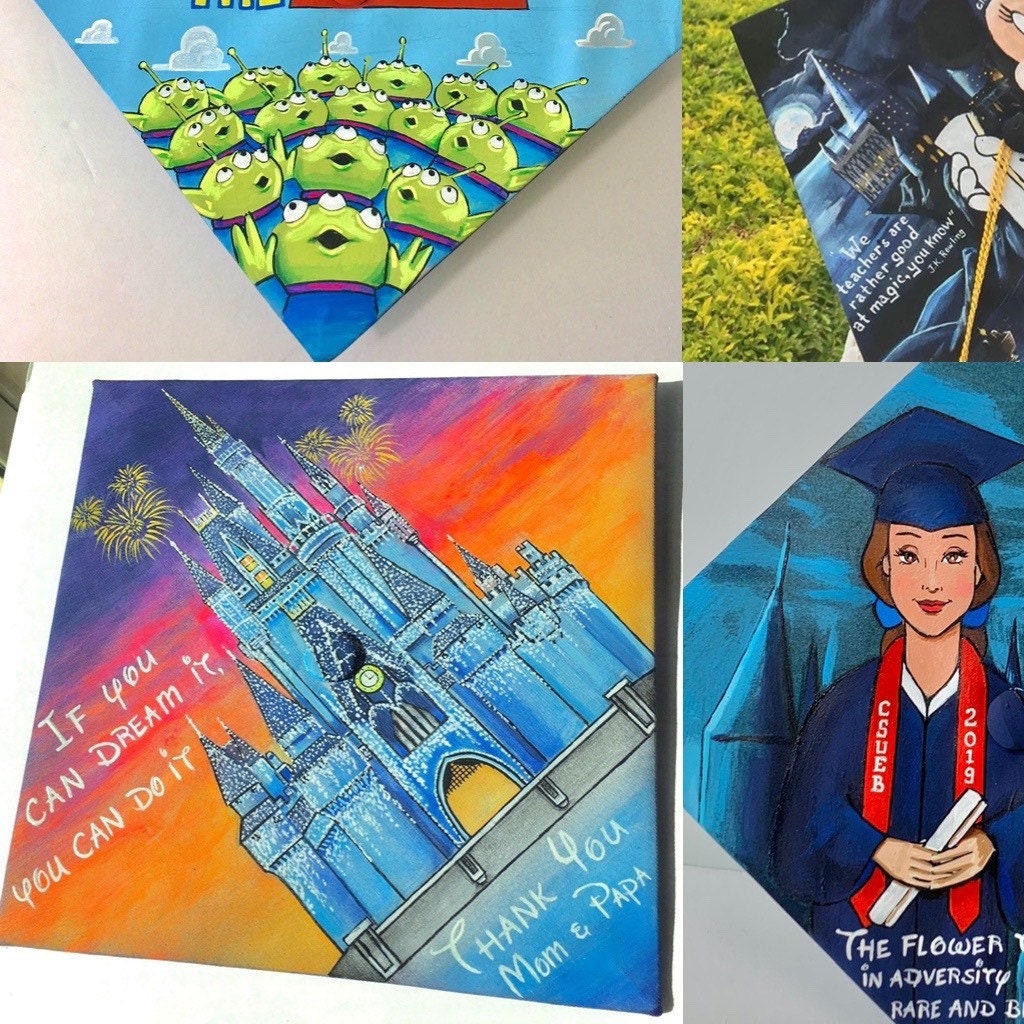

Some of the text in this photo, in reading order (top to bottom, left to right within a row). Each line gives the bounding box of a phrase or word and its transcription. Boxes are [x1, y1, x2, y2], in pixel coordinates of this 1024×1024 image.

[836, 215, 909, 295] teachers are
[849, 224, 920, 310] rather good
[852, 312, 871, 332] at
[25, 767, 85, 826] CAN
[88, 685, 184, 767] DREAM
[37, 704, 87, 752] IF
[870, 700, 891, 793] CSUEB
[963, 707, 978, 785] 2019
[72, 806, 125, 859] CAN
[125, 776, 165, 811] DO
[429, 882, 558, 974] THANK
[498, 866, 652, 998] Mom & PAPA
[835, 927, 892, 962] THE
[901, 933, 1003, 957] FLOWER
[889, 959, 1011, 996] ADVERSITY
[891, 999, 942, 1020] RARE
[948, 999, 996, 1018] AND
